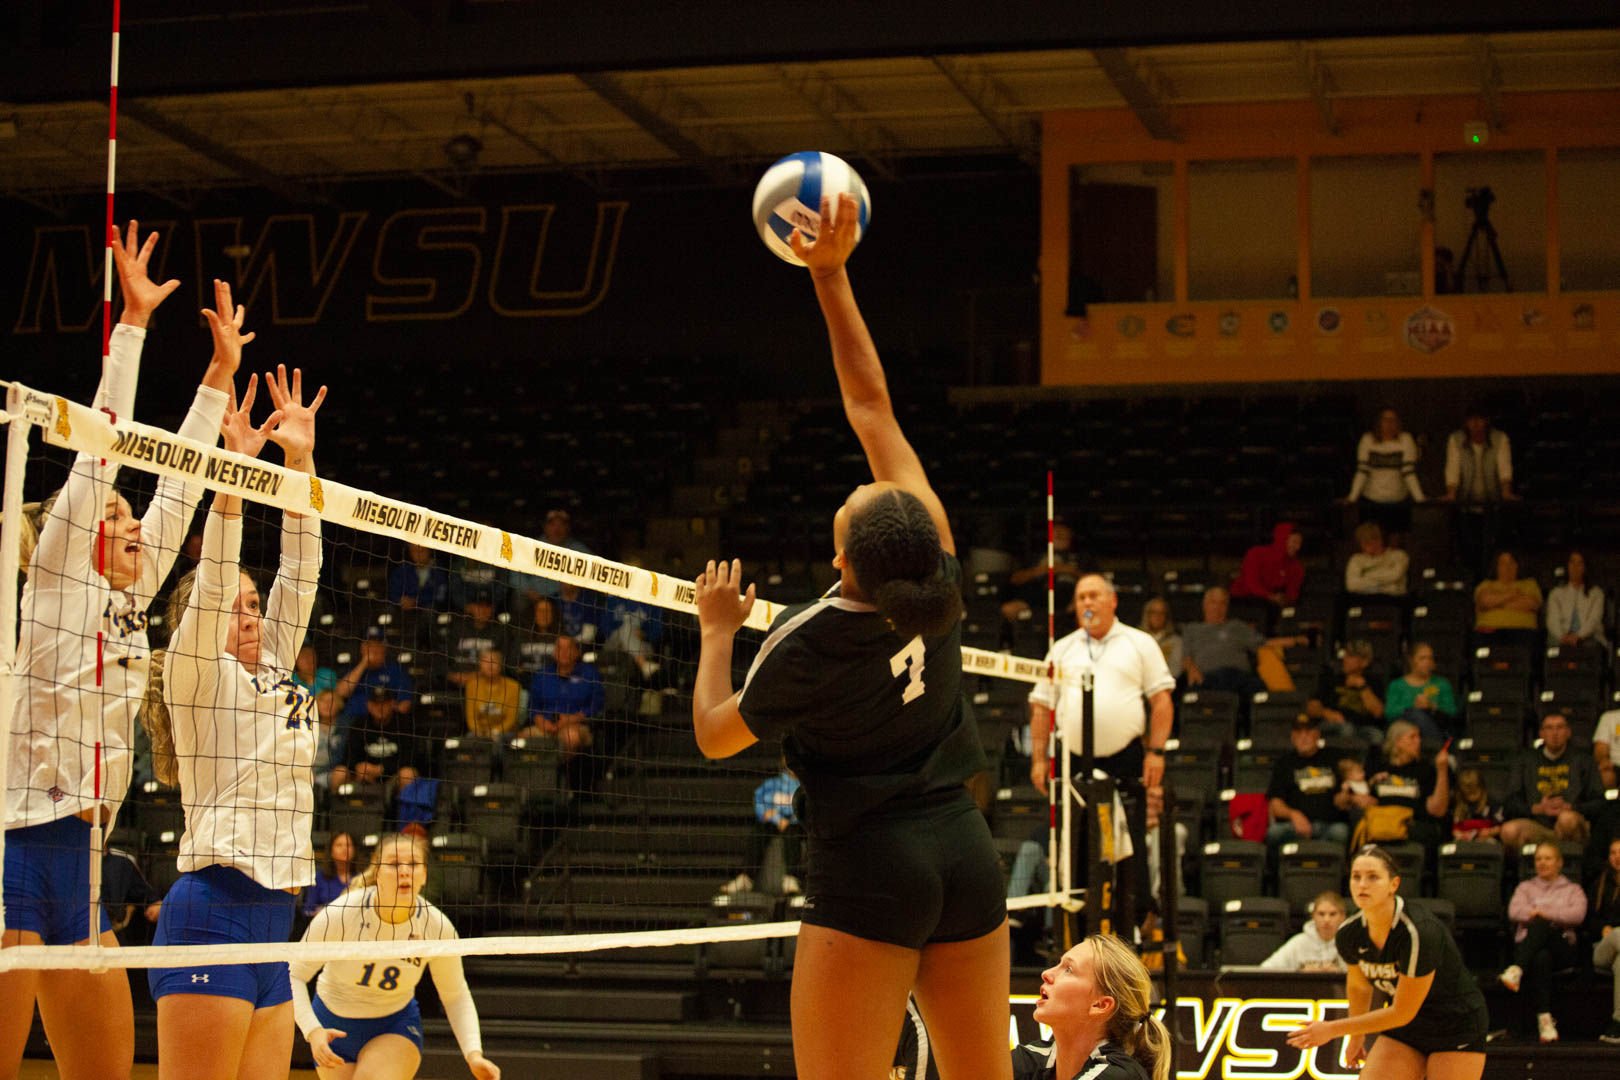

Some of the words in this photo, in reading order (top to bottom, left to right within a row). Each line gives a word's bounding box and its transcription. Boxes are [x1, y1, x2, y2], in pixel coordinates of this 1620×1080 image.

[111, 429, 202, 475] MISSOURI
[205, 455, 284, 497] WESTERN
[352, 497, 422, 534] MISSOURI
[423, 518, 482, 550] WESTERN
[535, 547, 588, 578] MISSOURI
[591, 560, 632, 589] WESTERN
[889, 633, 927, 707] 7
[356, 962, 401, 991] 18
